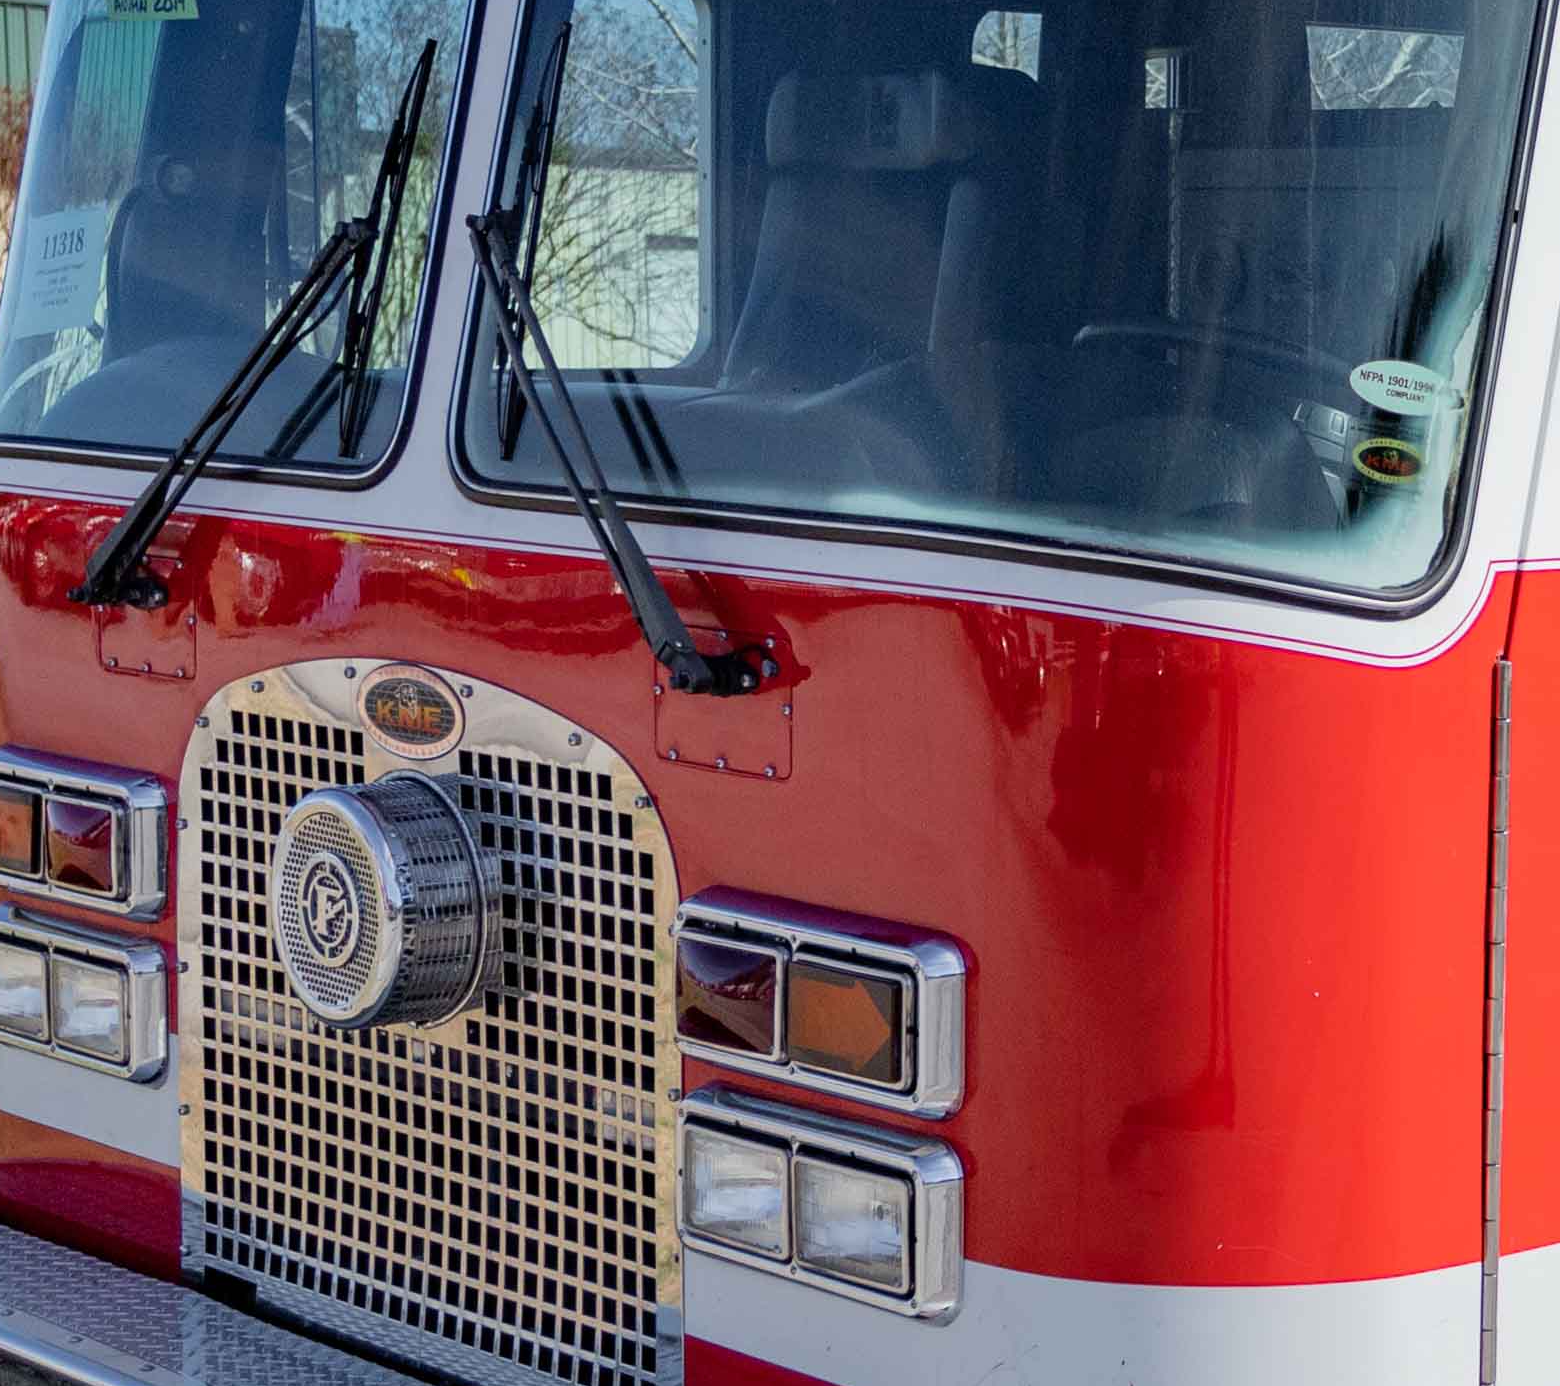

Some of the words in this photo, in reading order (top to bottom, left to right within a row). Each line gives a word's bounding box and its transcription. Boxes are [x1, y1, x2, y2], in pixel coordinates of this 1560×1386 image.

[42, 227, 85, 260] 11318
[1360, 369, 1384, 384] NFPA
[1385, 388, 1425, 403] COMPLIANT
[1367, 454, 1417, 476] KME
[376, 698, 442, 735] KME
